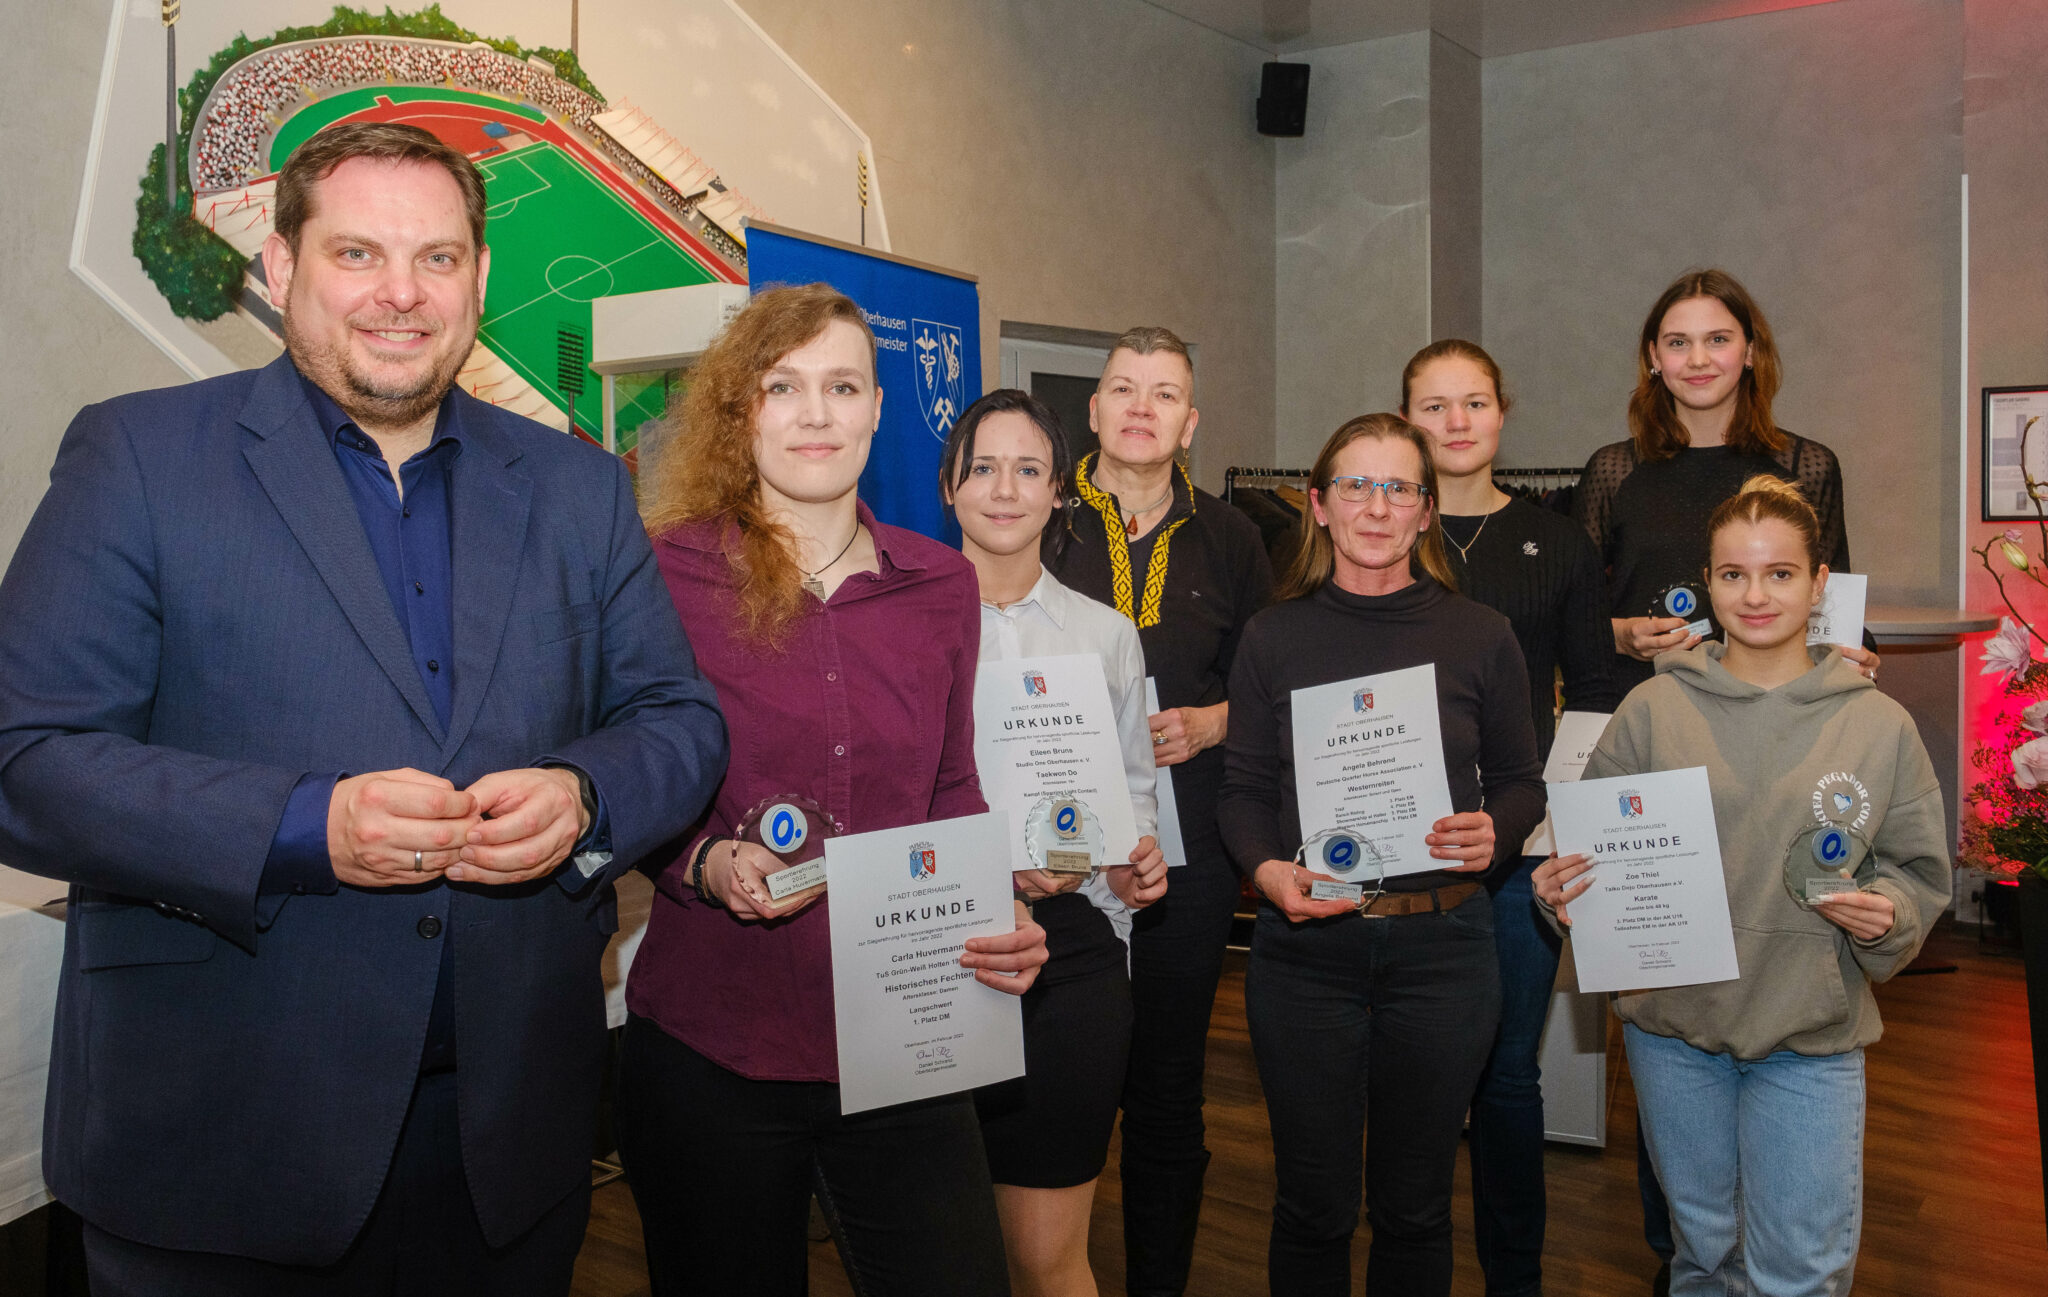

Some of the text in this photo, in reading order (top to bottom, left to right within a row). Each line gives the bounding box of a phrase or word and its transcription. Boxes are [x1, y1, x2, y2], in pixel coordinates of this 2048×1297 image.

[875, 336, 908, 352] rmeister
[1030, 701, 1070, 710] OBERHAUSEN
[1003, 714, 1085, 730] URKUNDE
[1336, 714, 1394, 729] STADT OBERHAUSEN
[1327, 724, 1406, 748] URKUNDE
[1029, 747, 1074, 757] Eileen Bruns
[1342, 757, 1396, 773] Angela Behrend
[1036, 769, 1078, 779] Taekwon Do
[1316, 778, 1341, 787] Deutsche
[1341, 773, 1362, 783] Quarter
[1380, 765, 1412, 775] Association
[1347, 779, 1395, 793] Westernreiten
[1817, 771, 1869, 800] PEGADOR
[1624, 823, 1667, 832] OBERHAUSEN
[1594, 835, 1682, 854] URKUNDE
[775, 862, 820, 883] Sportlerehrung
[791, 873, 807, 883] 2022
[1641, 871, 1660, 879] Thiel
[775, 885, 792, 896] Carla
[887, 883, 961, 902] STADT OBERHAUSEN
[1636, 881, 1672, 890] Oberhausen
[1633, 894, 1659, 903] Karate
[875, 899, 976, 928] URKUNDE
[891, 943, 964, 963] Carla Huvermann
[875, 970, 890, 979] TuS
[890, 963, 927, 977] Grün-Weiß
[928, 959, 950, 970] Holten
[884, 970, 974, 994] Historisches Fechten
[939, 986, 959, 994] Damen
[909, 1000, 953, 1015] Langschwert
[920, 1015, 938, 1025] Platz
[939, 1012, 951, 1021] DM
